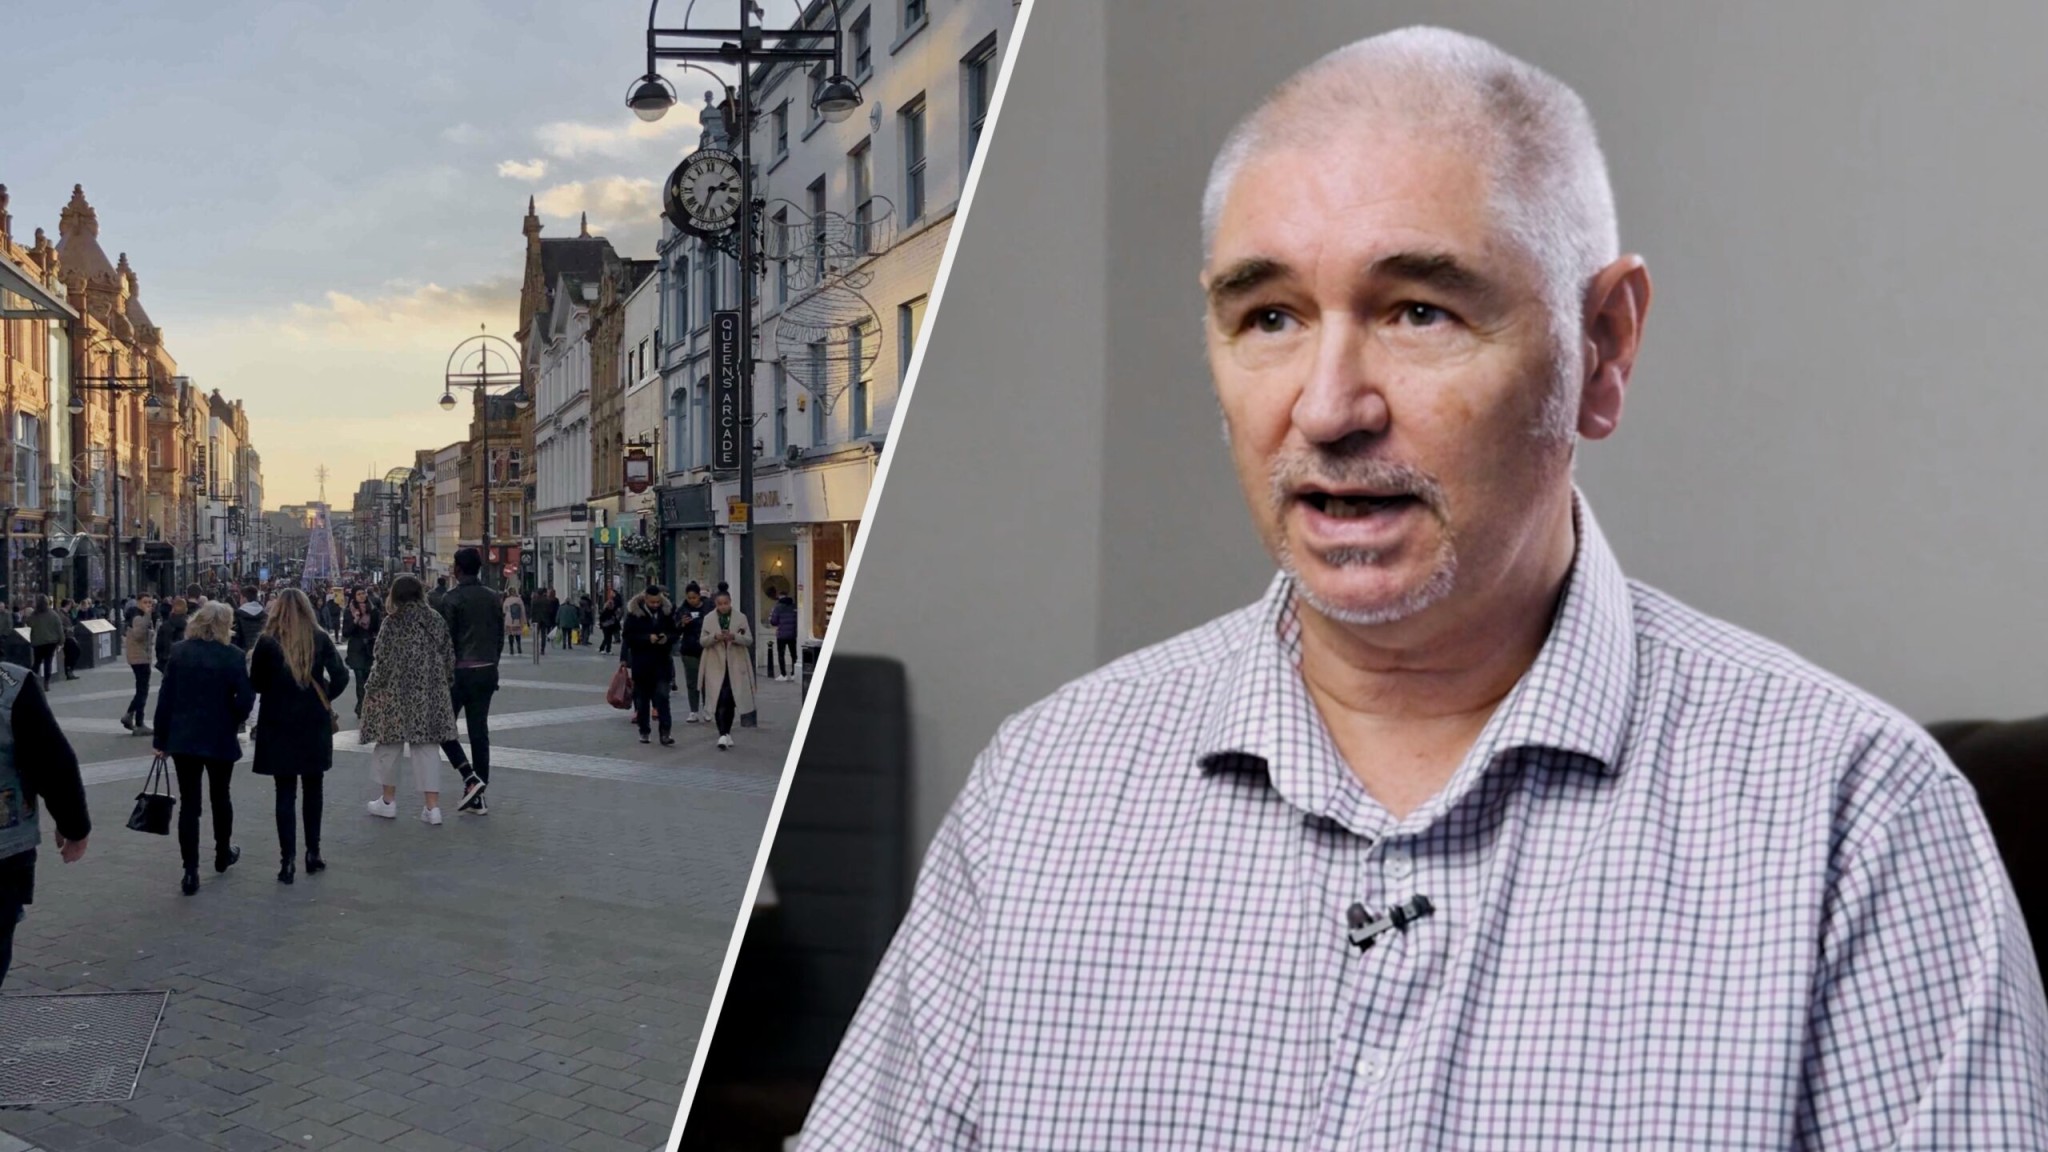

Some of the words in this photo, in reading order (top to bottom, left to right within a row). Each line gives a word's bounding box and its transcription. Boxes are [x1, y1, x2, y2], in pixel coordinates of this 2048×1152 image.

[689, 150, 731, 162] QUEEN'S
[693, 219, 729, 230] ARCADE
[722, 319, 735, 388] QUEEN'S
[722, 393, 733, 462] ARCADE
